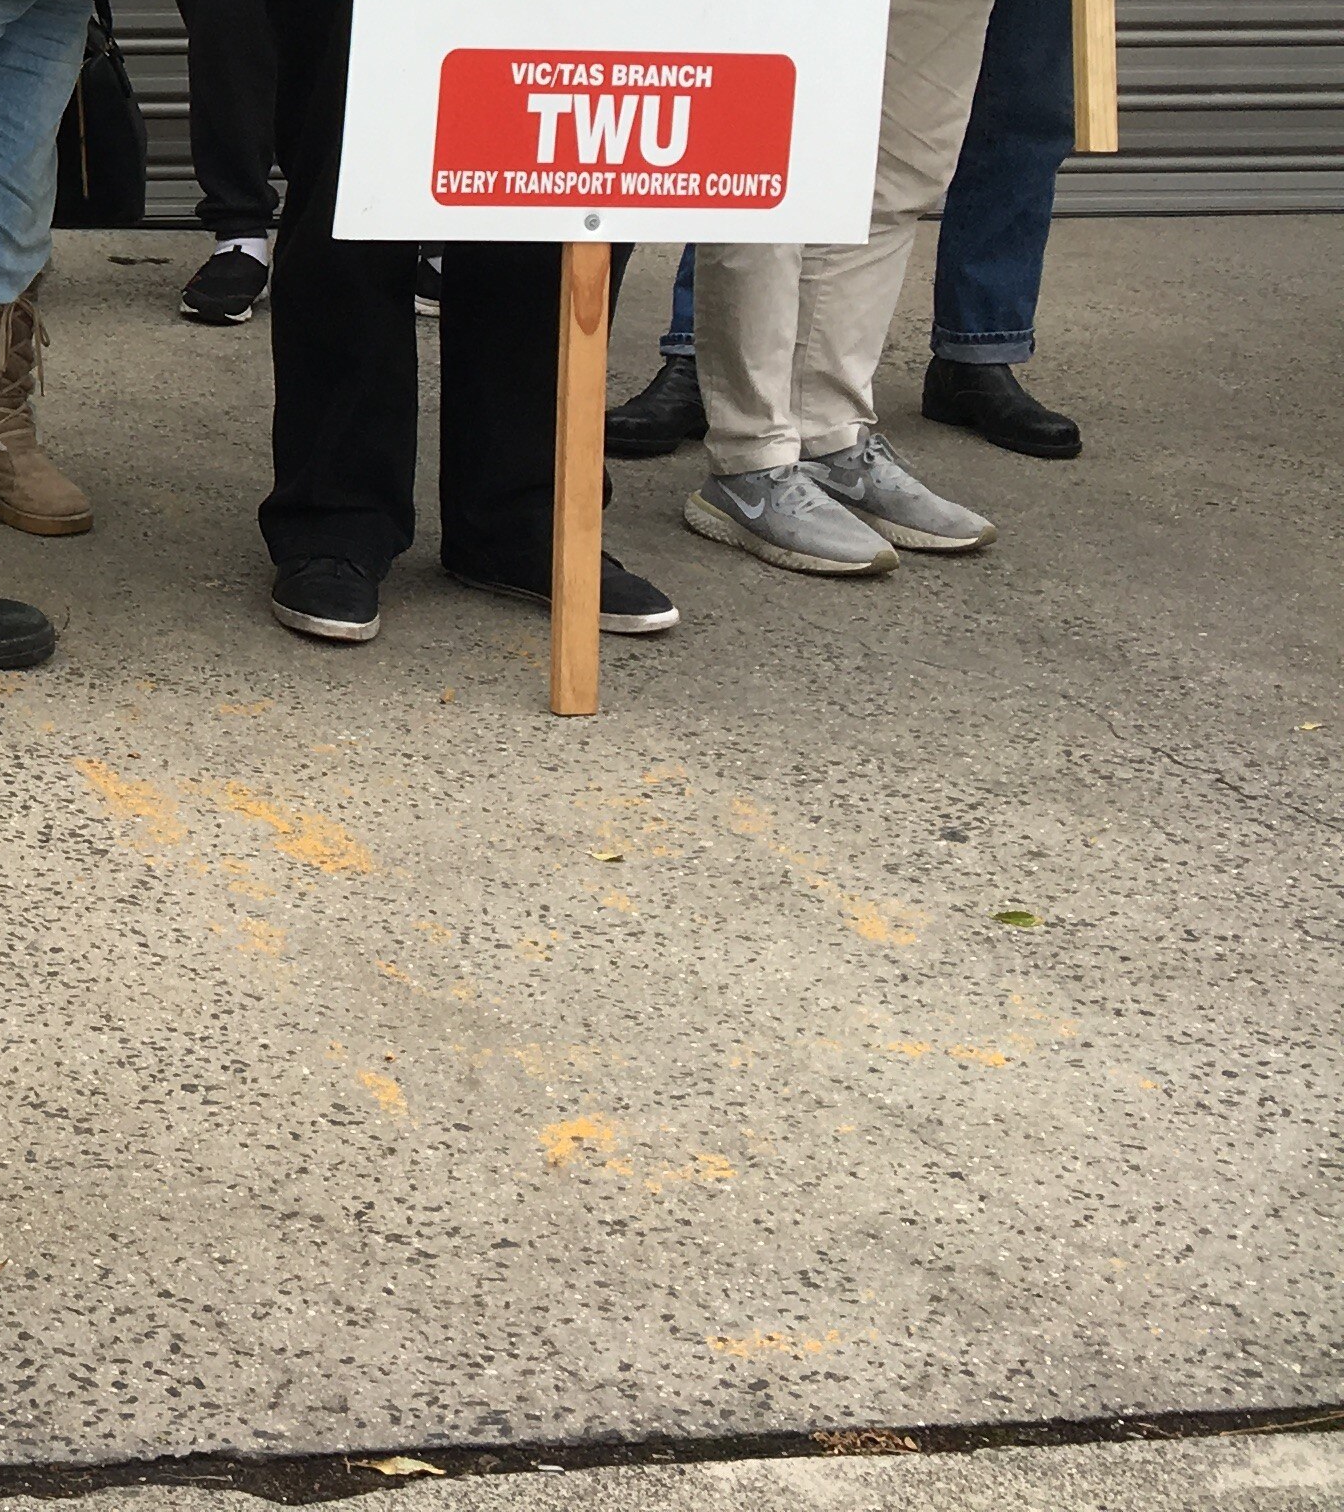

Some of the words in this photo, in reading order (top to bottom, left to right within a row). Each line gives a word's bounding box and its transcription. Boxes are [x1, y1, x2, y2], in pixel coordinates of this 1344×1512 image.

[511, 62, 605, 88] VIC/TAS
[612, 64, 713, 88] BRANCH
[527, 93, 691, 167] TWU
[437, 170, 498, 194] EVERY
[503, 171, 617, 195] TRANSPORT
[620, 172, 701, 196] WORKER
[706, 173, 782, 197] COUNTS
